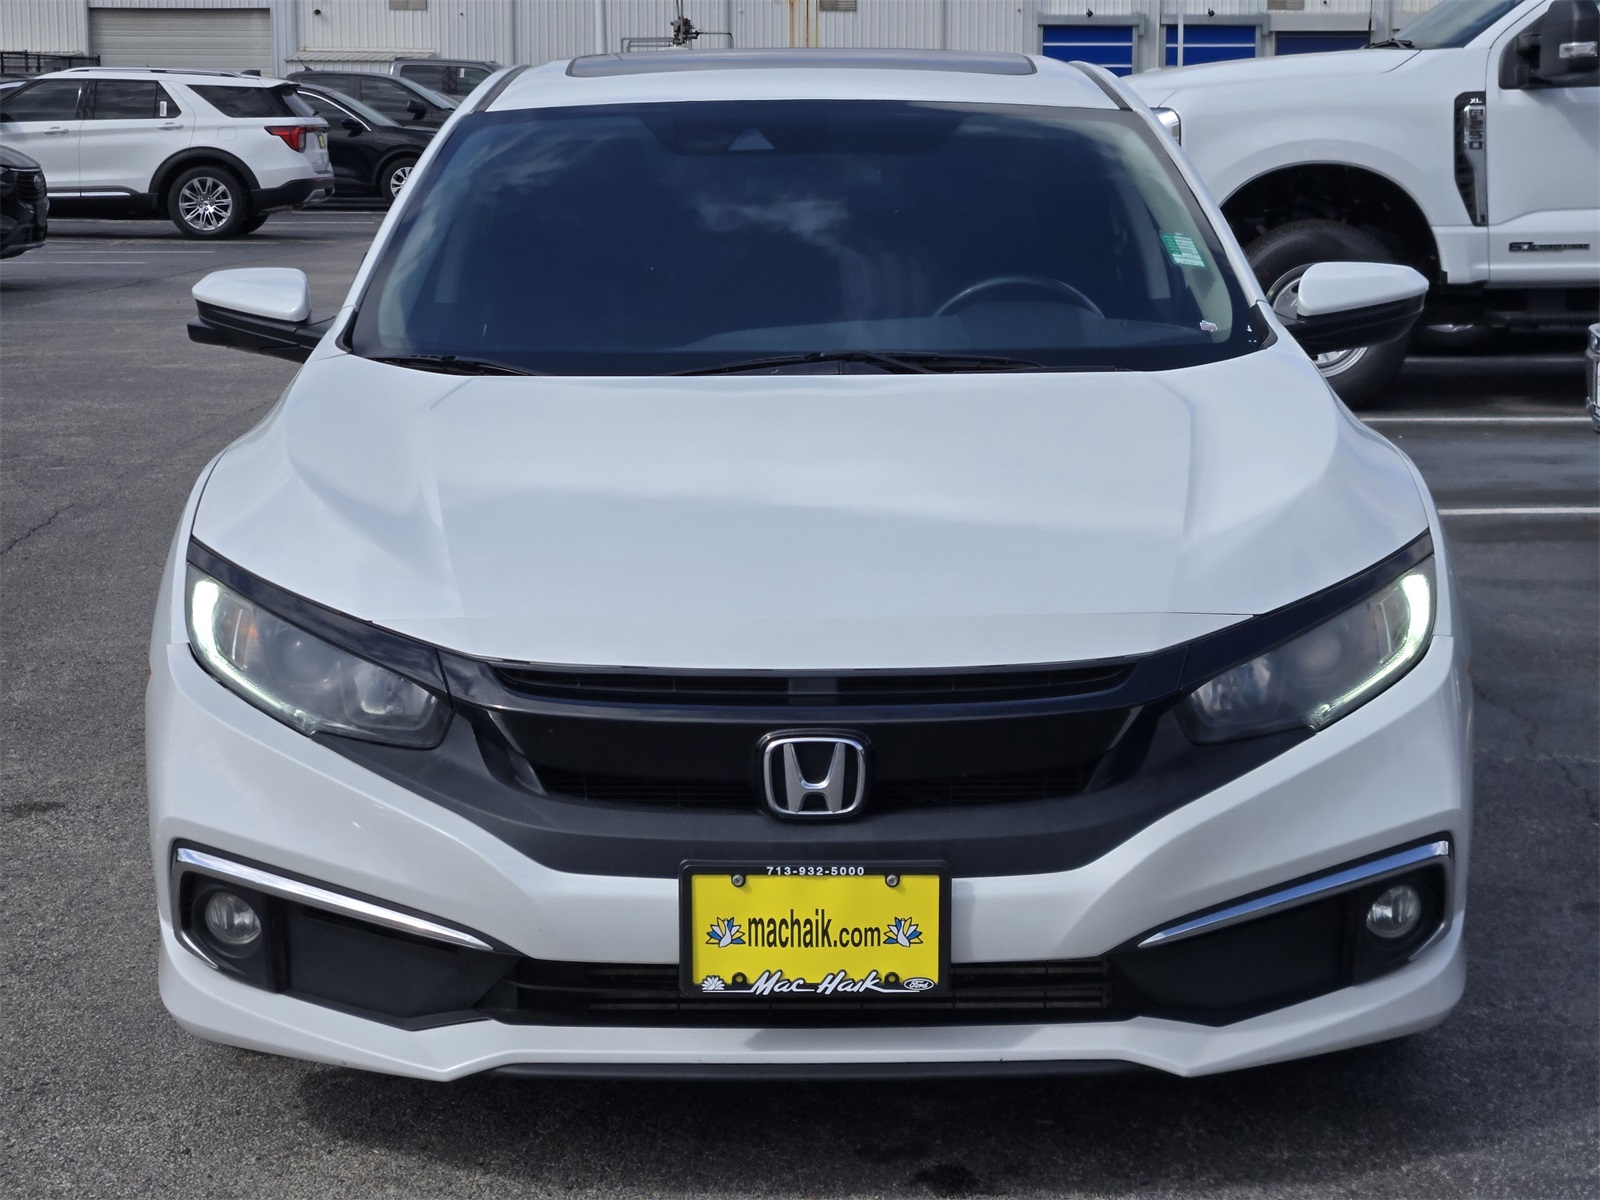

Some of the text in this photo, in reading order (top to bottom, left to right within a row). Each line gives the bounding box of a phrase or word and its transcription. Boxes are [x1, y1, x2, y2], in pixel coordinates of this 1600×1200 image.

[766, 866, 865, 876] 713-932-5000
[748, 909, 881, 948] machaik.com
[751, 969, 883, 996] Mac Haik
